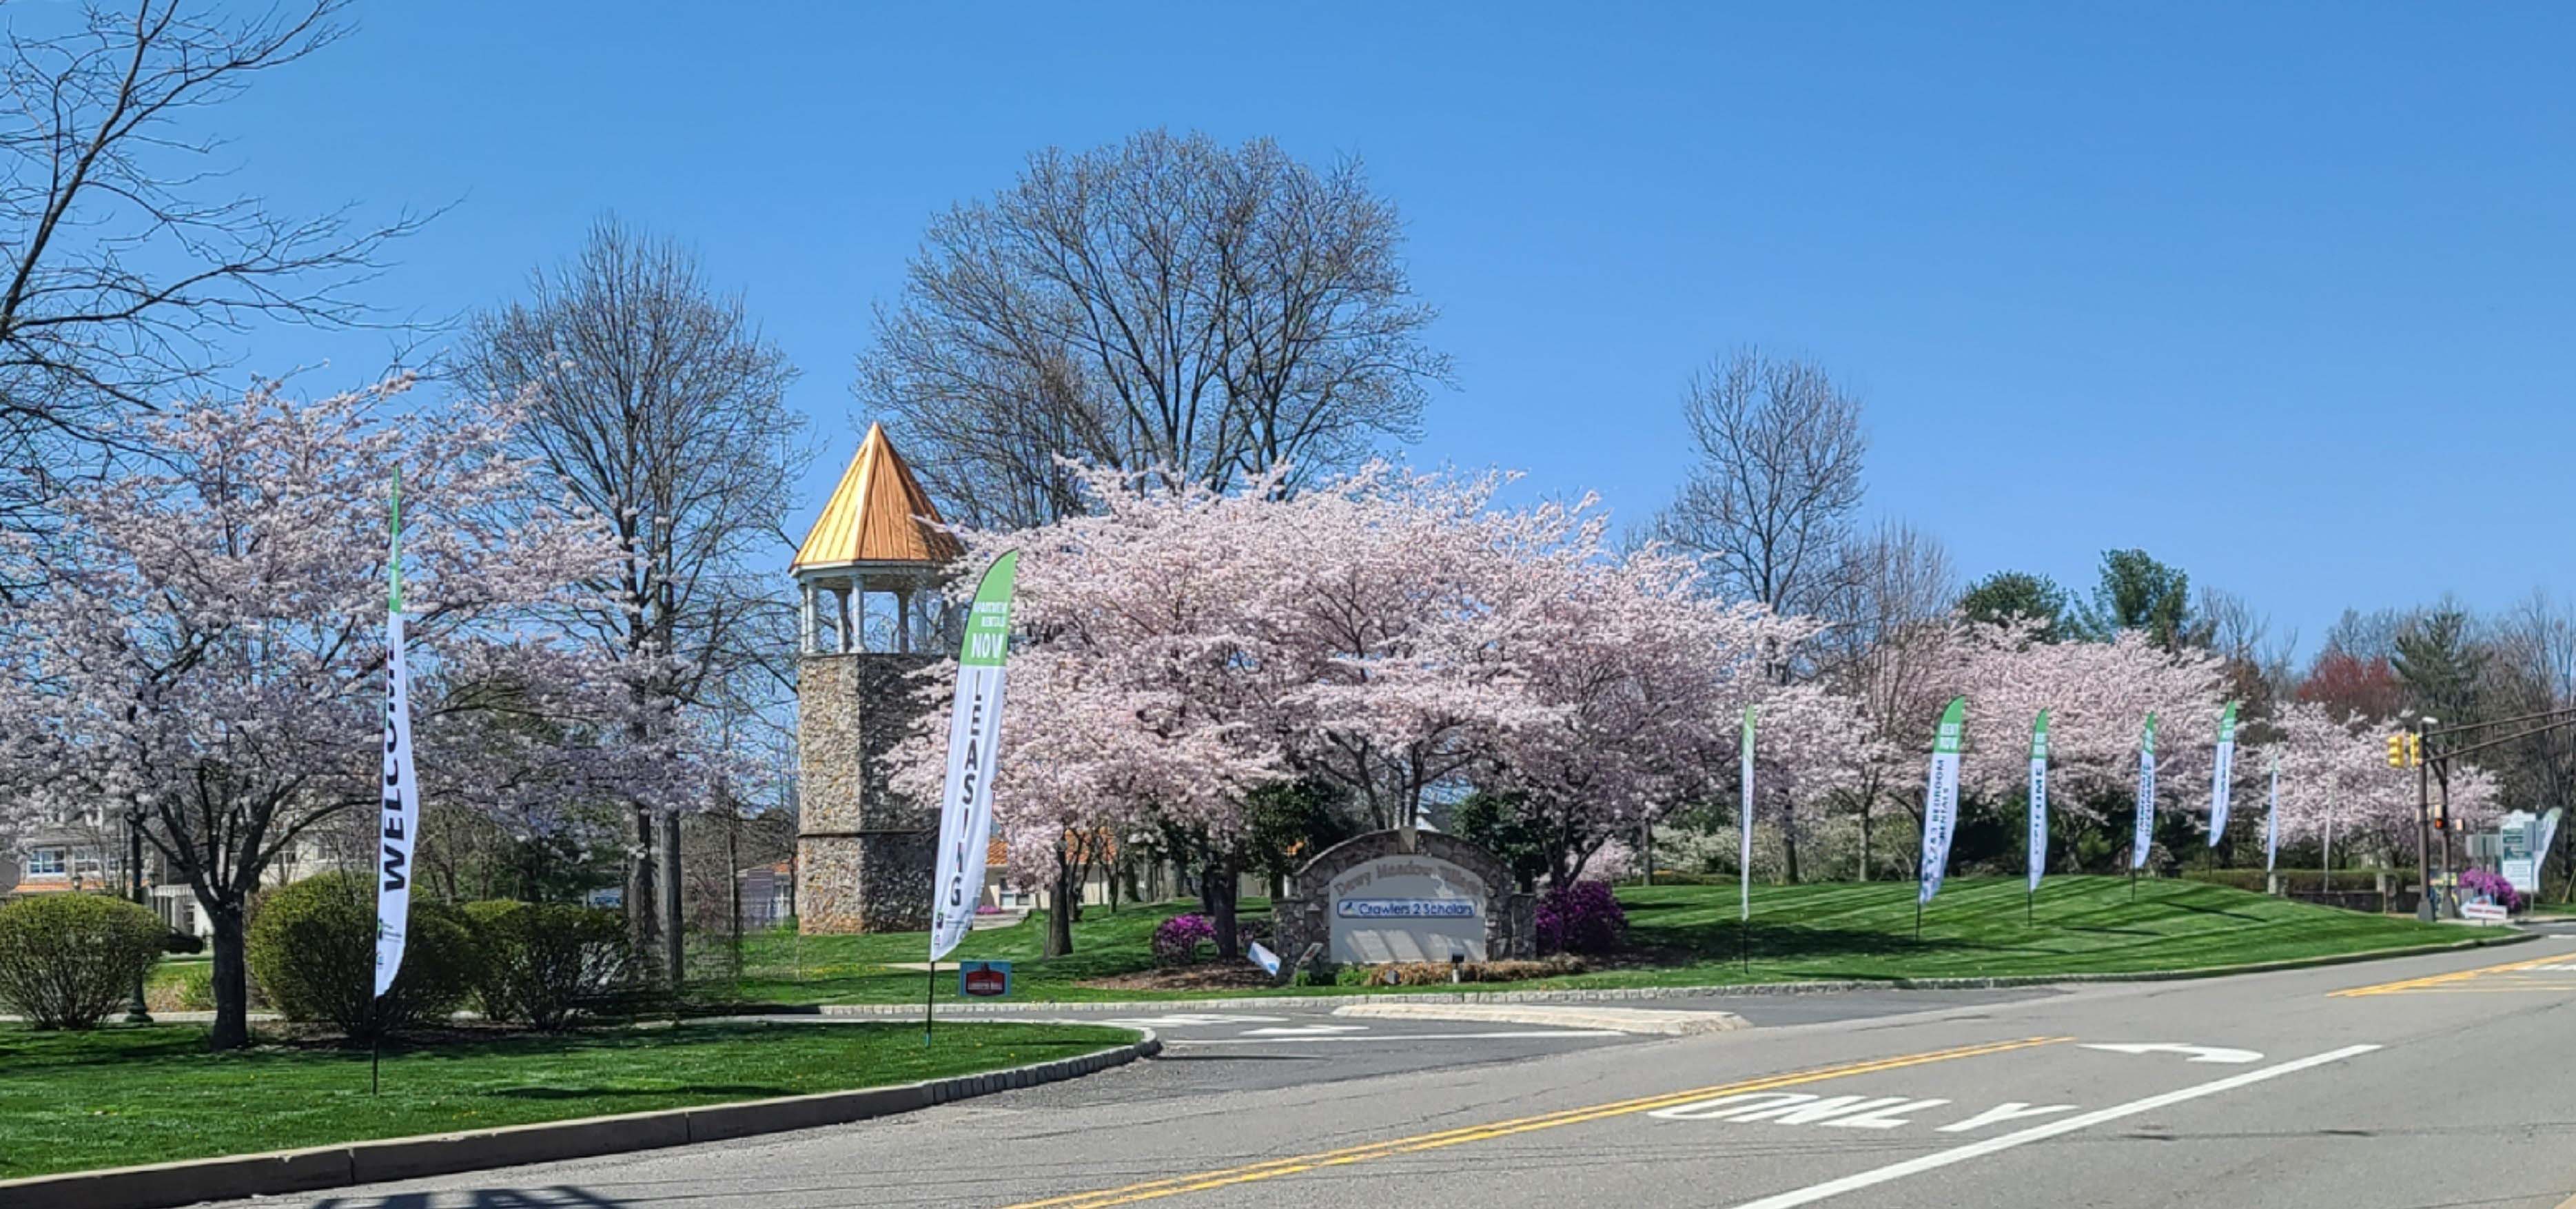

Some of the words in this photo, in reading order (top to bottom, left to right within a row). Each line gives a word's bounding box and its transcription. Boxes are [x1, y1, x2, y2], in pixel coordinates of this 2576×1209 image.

[1932, 760, 1944, 822] BEDROOM
[1358, 903, 1410, 915] Crawlers
[1413, 904, 1421, 915] 2
[1424, 903, 1473, 915] Scholars
[1648, 1092, 2080, 1132] ONLY
